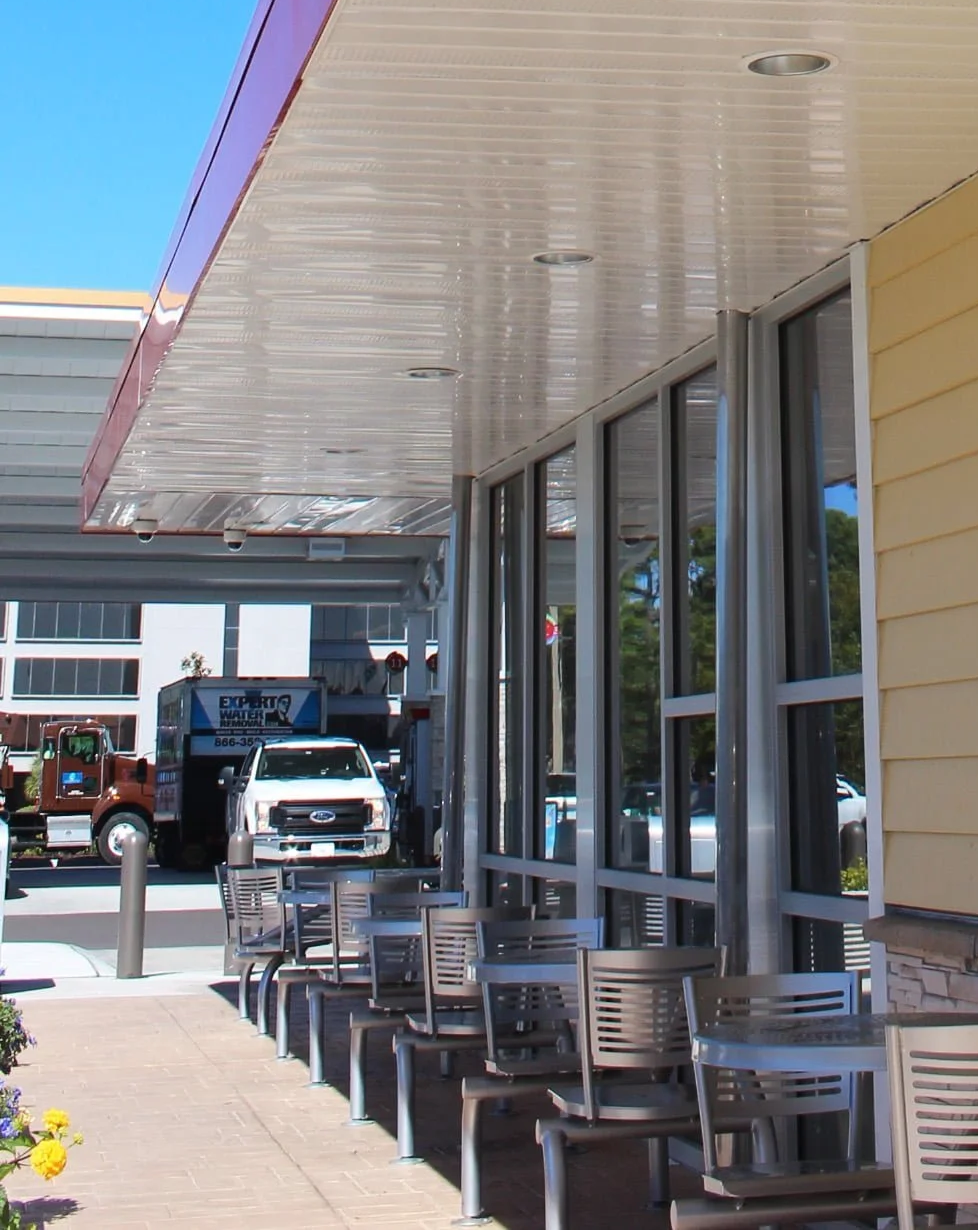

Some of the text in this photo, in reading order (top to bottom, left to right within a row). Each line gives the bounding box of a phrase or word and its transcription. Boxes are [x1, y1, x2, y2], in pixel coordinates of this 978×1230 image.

[219, 696, 277, 709] EXPERT
[220, 709, 264, 720] WATER
[219, 719, 265, 728] REMOVAL
